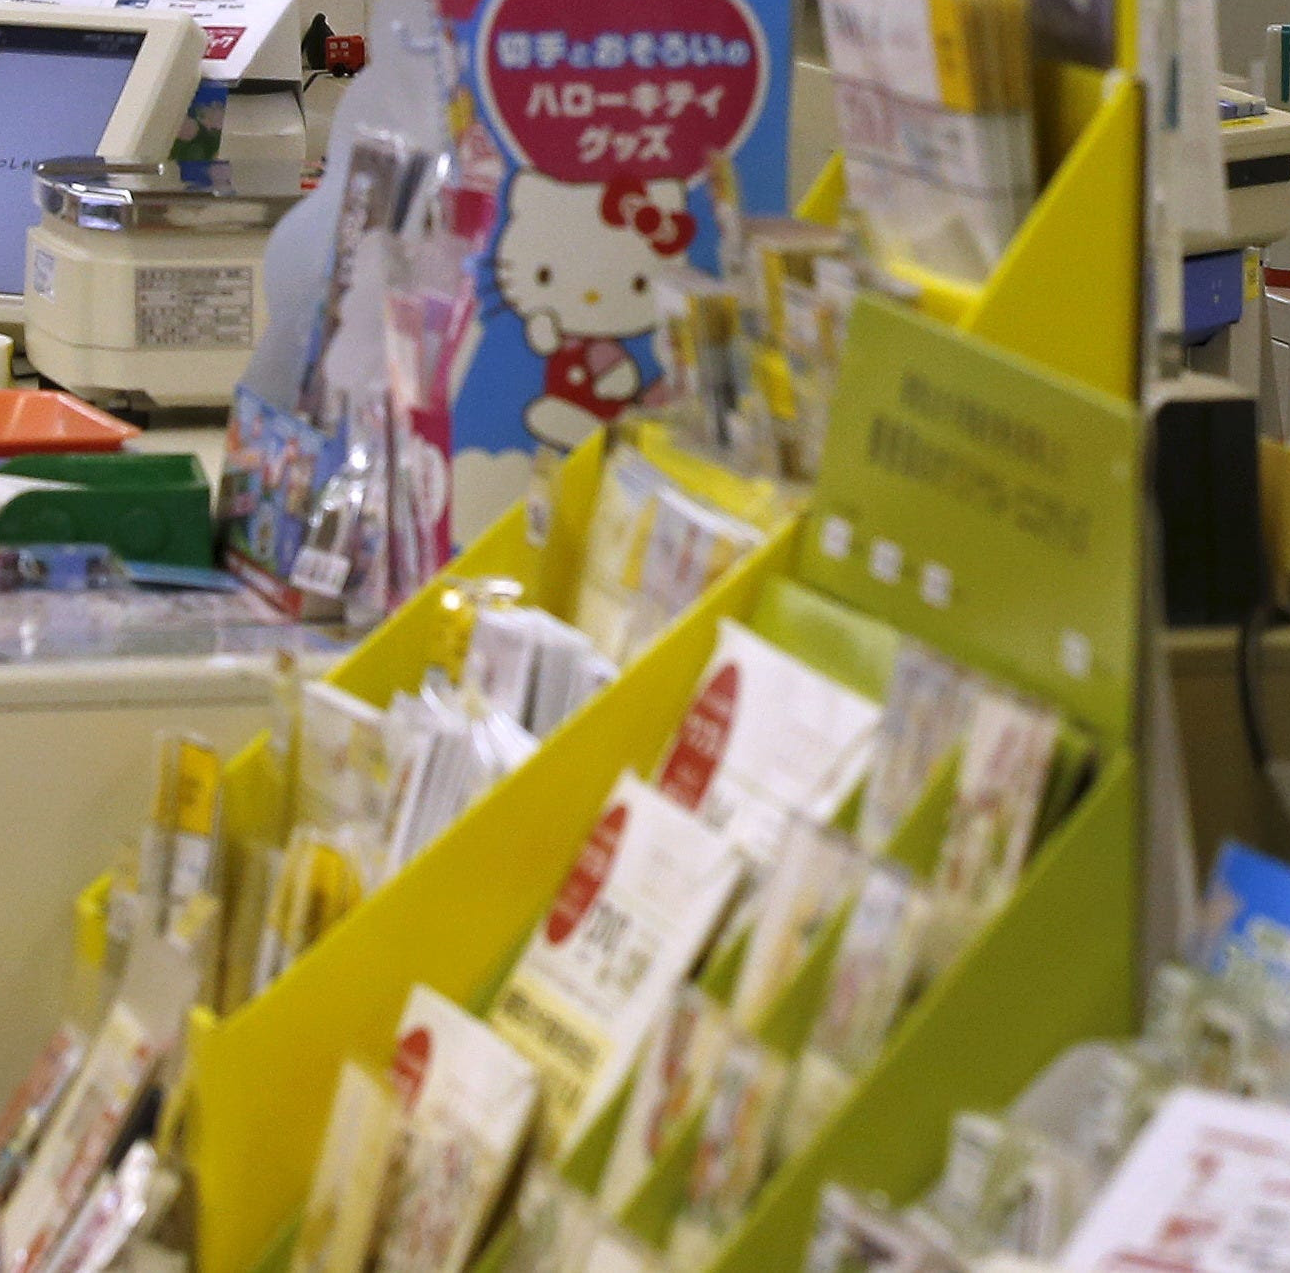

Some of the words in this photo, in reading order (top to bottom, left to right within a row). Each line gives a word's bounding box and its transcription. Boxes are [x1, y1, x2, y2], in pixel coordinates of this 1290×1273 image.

[496, 29, 752, 71] 切手とおそろいの
[525, 80, 726, 120] ハローキティ
[576, 125, 674, 164] グッズ
